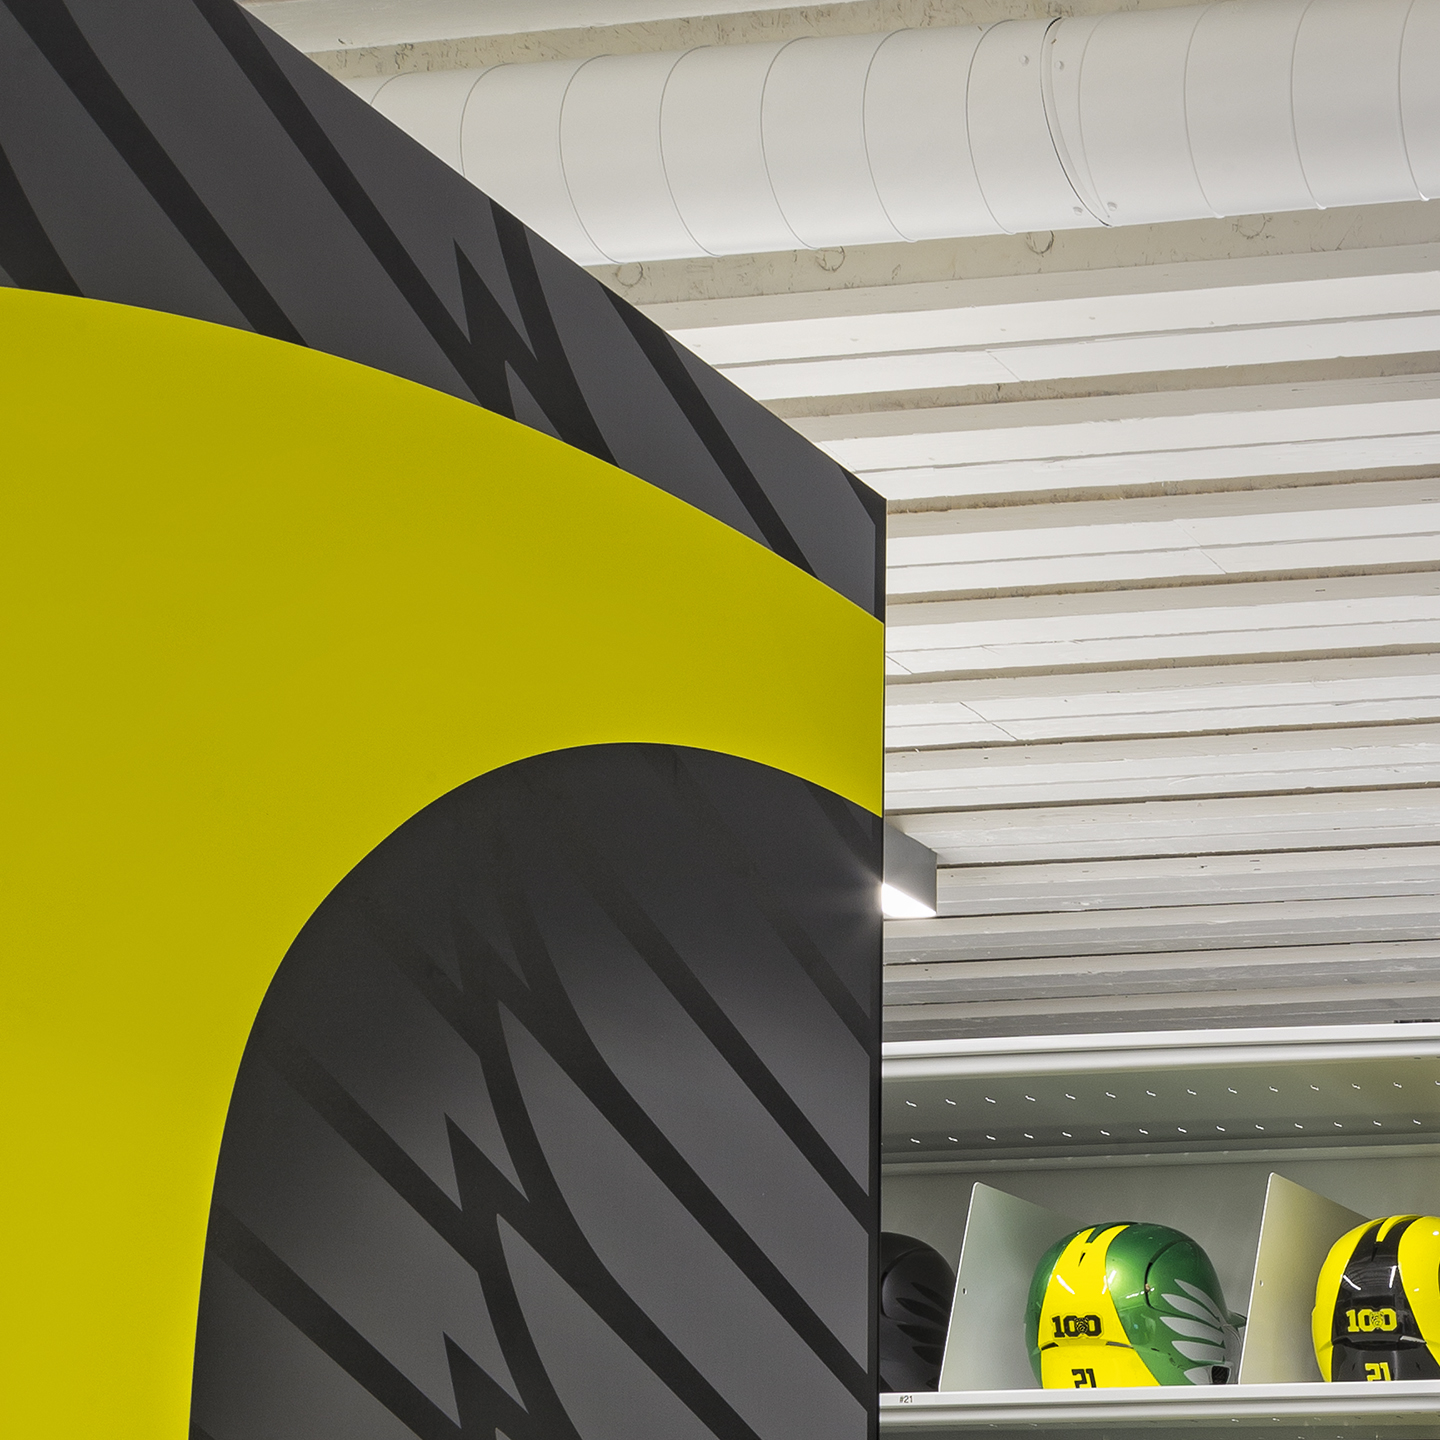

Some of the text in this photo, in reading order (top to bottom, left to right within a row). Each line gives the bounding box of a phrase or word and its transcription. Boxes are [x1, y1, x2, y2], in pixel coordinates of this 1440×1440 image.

[1051, 1315, 1102, 1338] 100
[1346, 1309, 1397, 1332] 100
[1072, 1368, 1095, 1388] 21
[1365, 1362, 1390, 1382] 21
